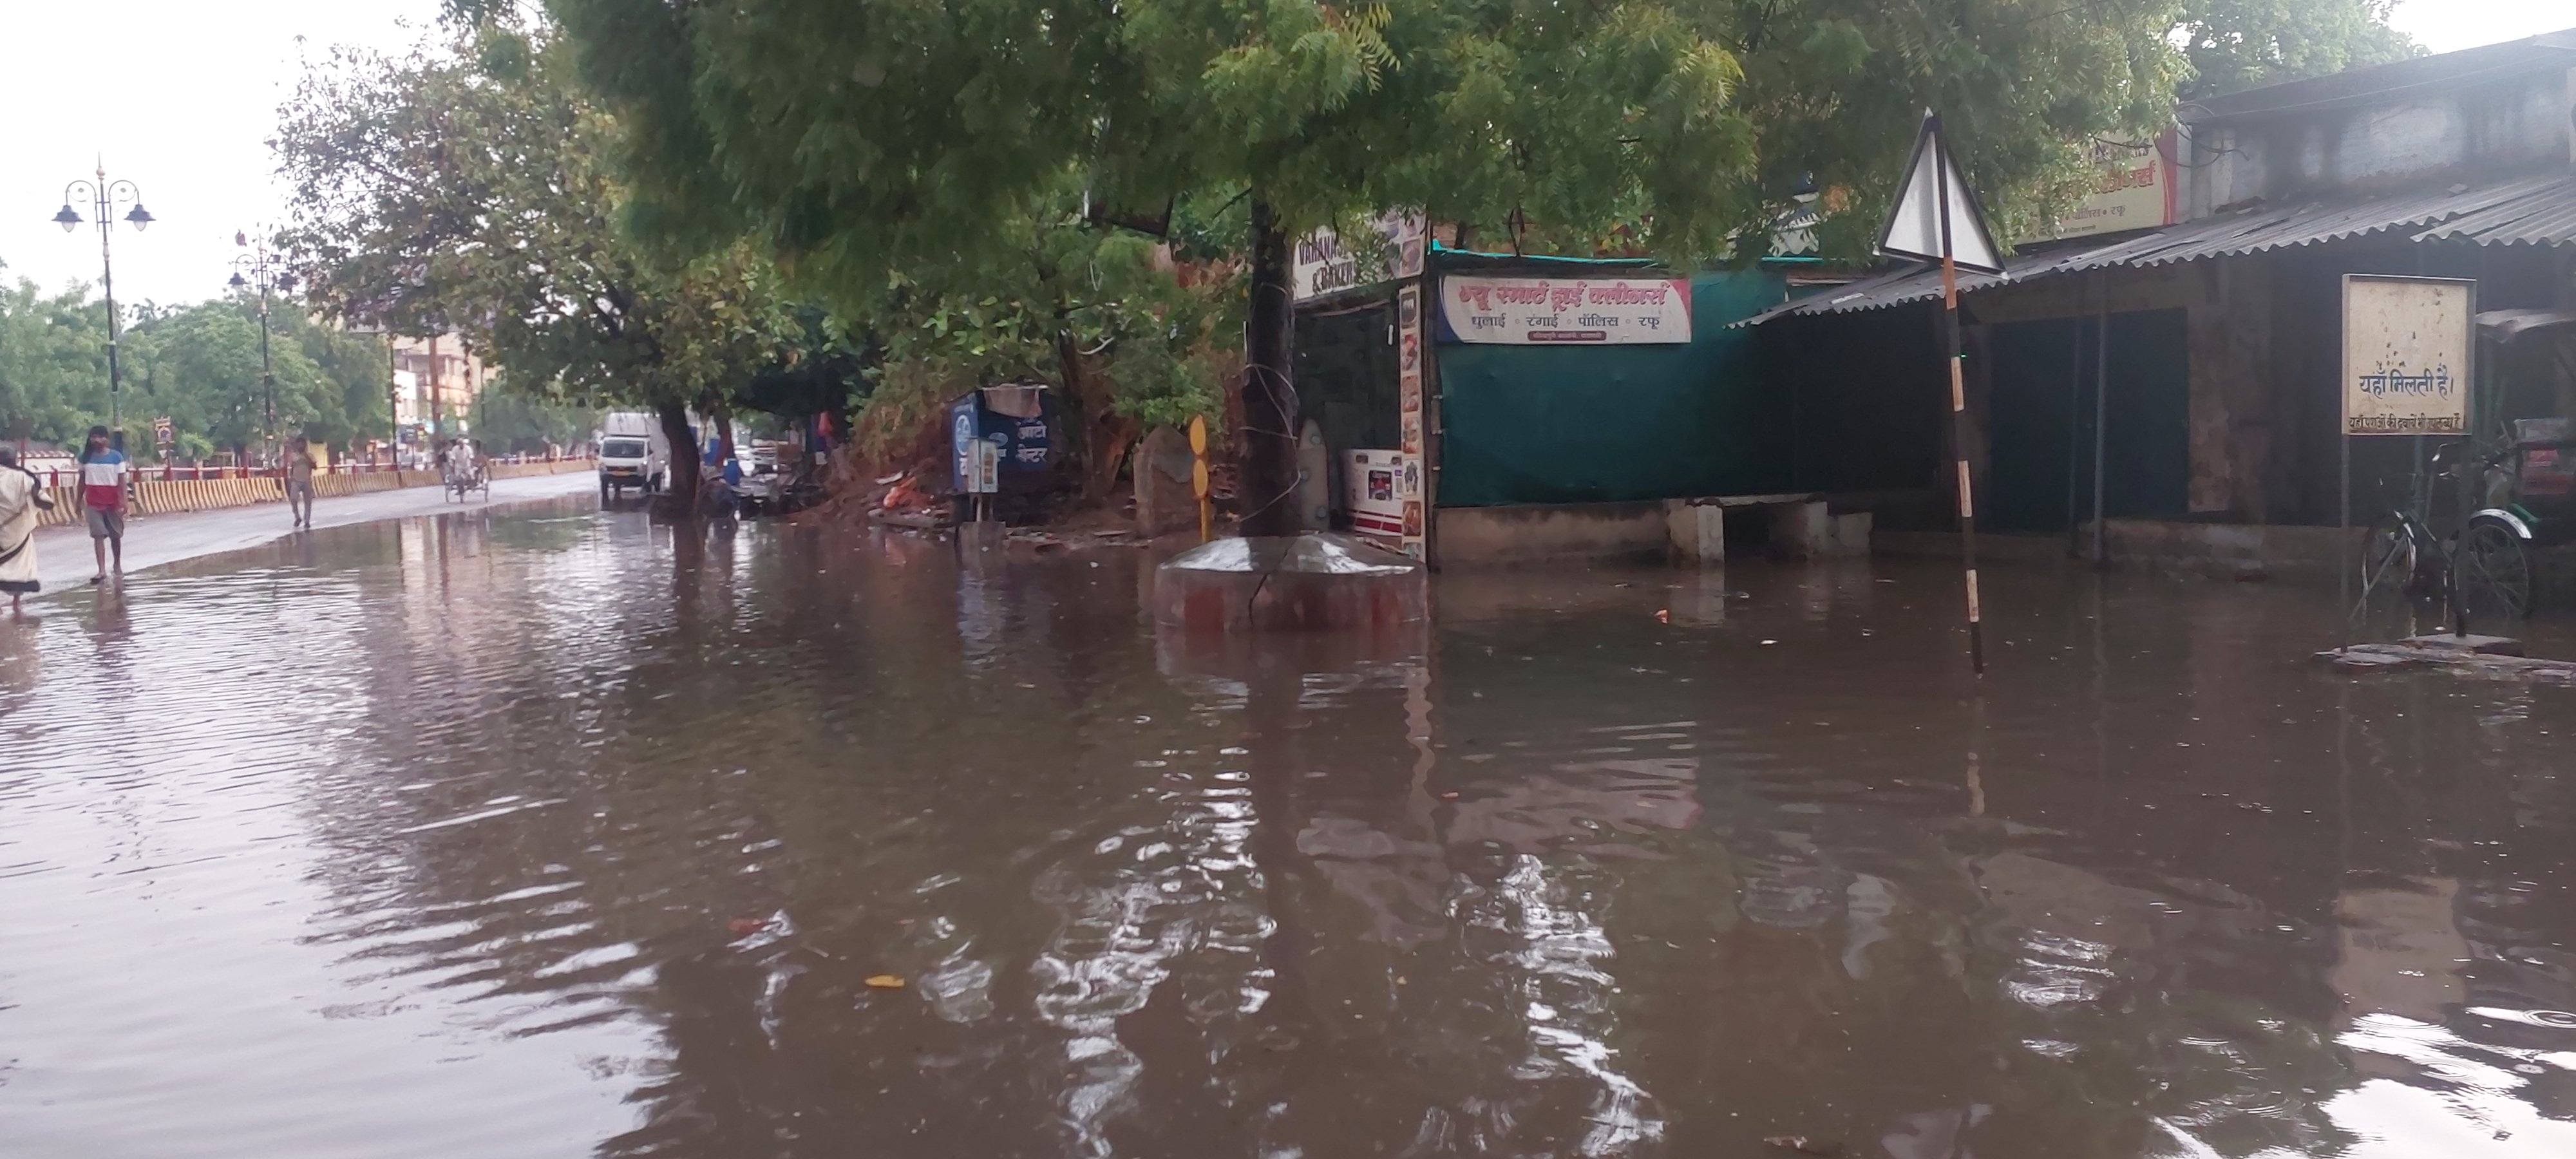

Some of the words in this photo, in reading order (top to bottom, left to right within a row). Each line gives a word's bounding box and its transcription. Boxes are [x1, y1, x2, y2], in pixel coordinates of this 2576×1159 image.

[1459, 283, 1492, 310] न्यू
[1496, 281, 1549, 305] स्मार्ट
[1551, 281, 1587, 311] ड्राई
[1588, 281, 1670, 305] क्लीनर्स
[1472, 312, 1506, 329] धुलाई
[1526, 312, 1558, 328] रंगाई
[1578, 313, 1618, 327] पॉलिस
[1638, 316, 1660, 330] रफू
[2359, 370, 2387, 400] यहाँ
[2389, 368, 2434, 397] मिलती
[2387, 413, 2396, 428] की
